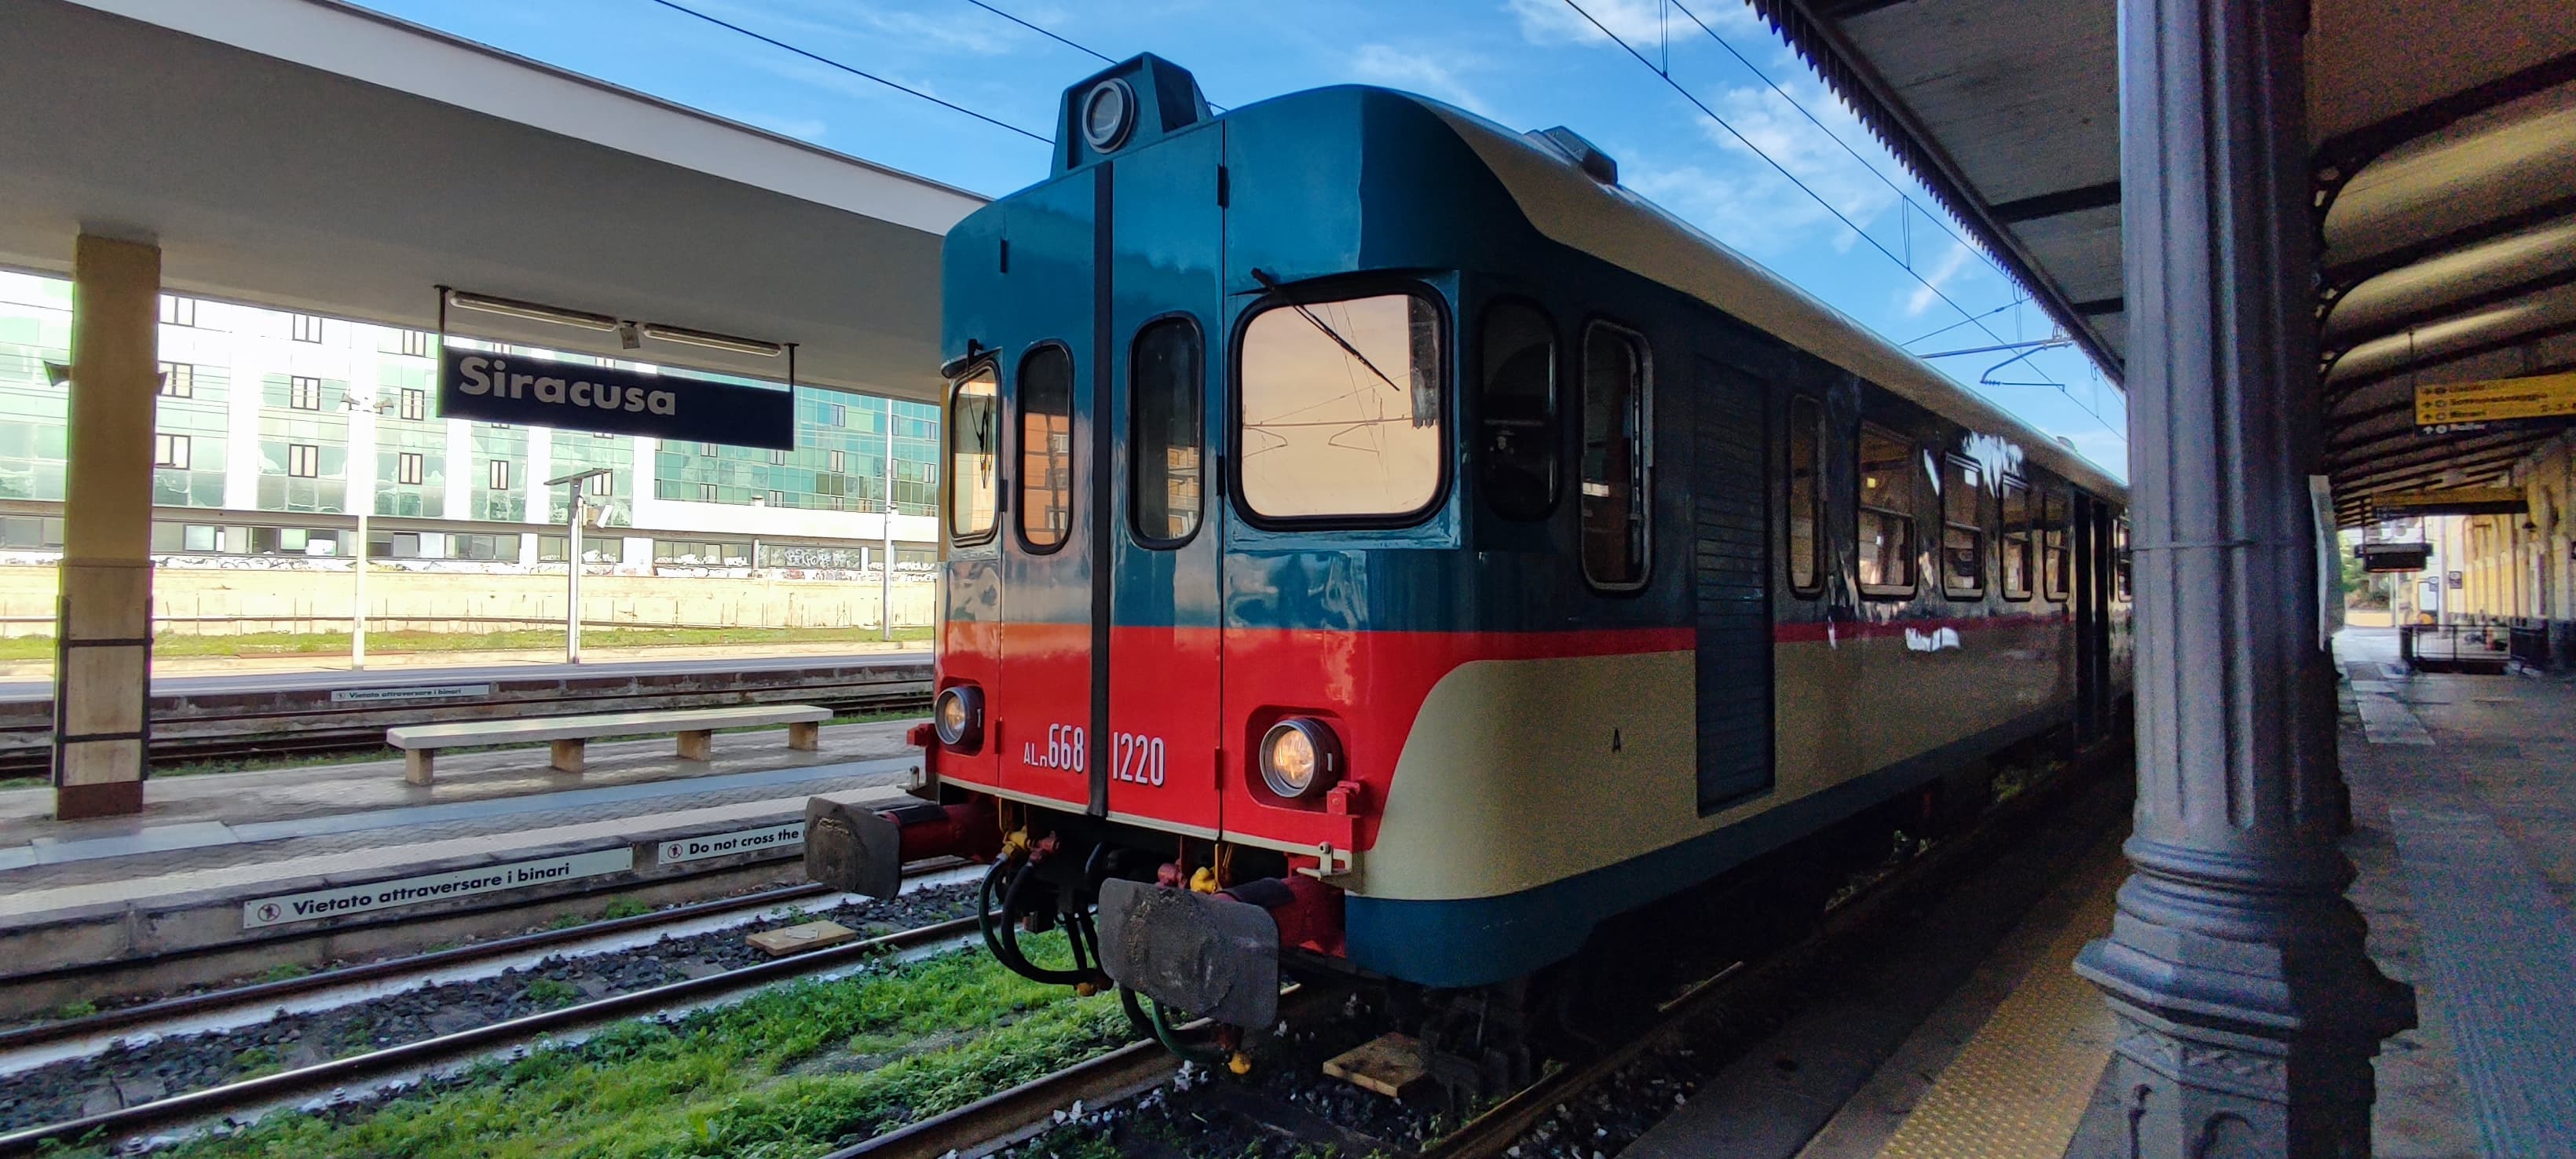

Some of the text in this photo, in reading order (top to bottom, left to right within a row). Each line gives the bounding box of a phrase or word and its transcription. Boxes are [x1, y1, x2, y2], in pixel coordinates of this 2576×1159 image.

[459, 356, 675, 415] Siracusa
[1113, 731, 1165, 787] 1220
[1612, 728, 1622, 753] A
[689, 843, 709, 855] Do
[713, 838, 737, 851] not
[741, 832, 774, 846] cross
[778, 829, 799, 841] the
[293, 863, 570, 916] Vietato attraversare i binari
